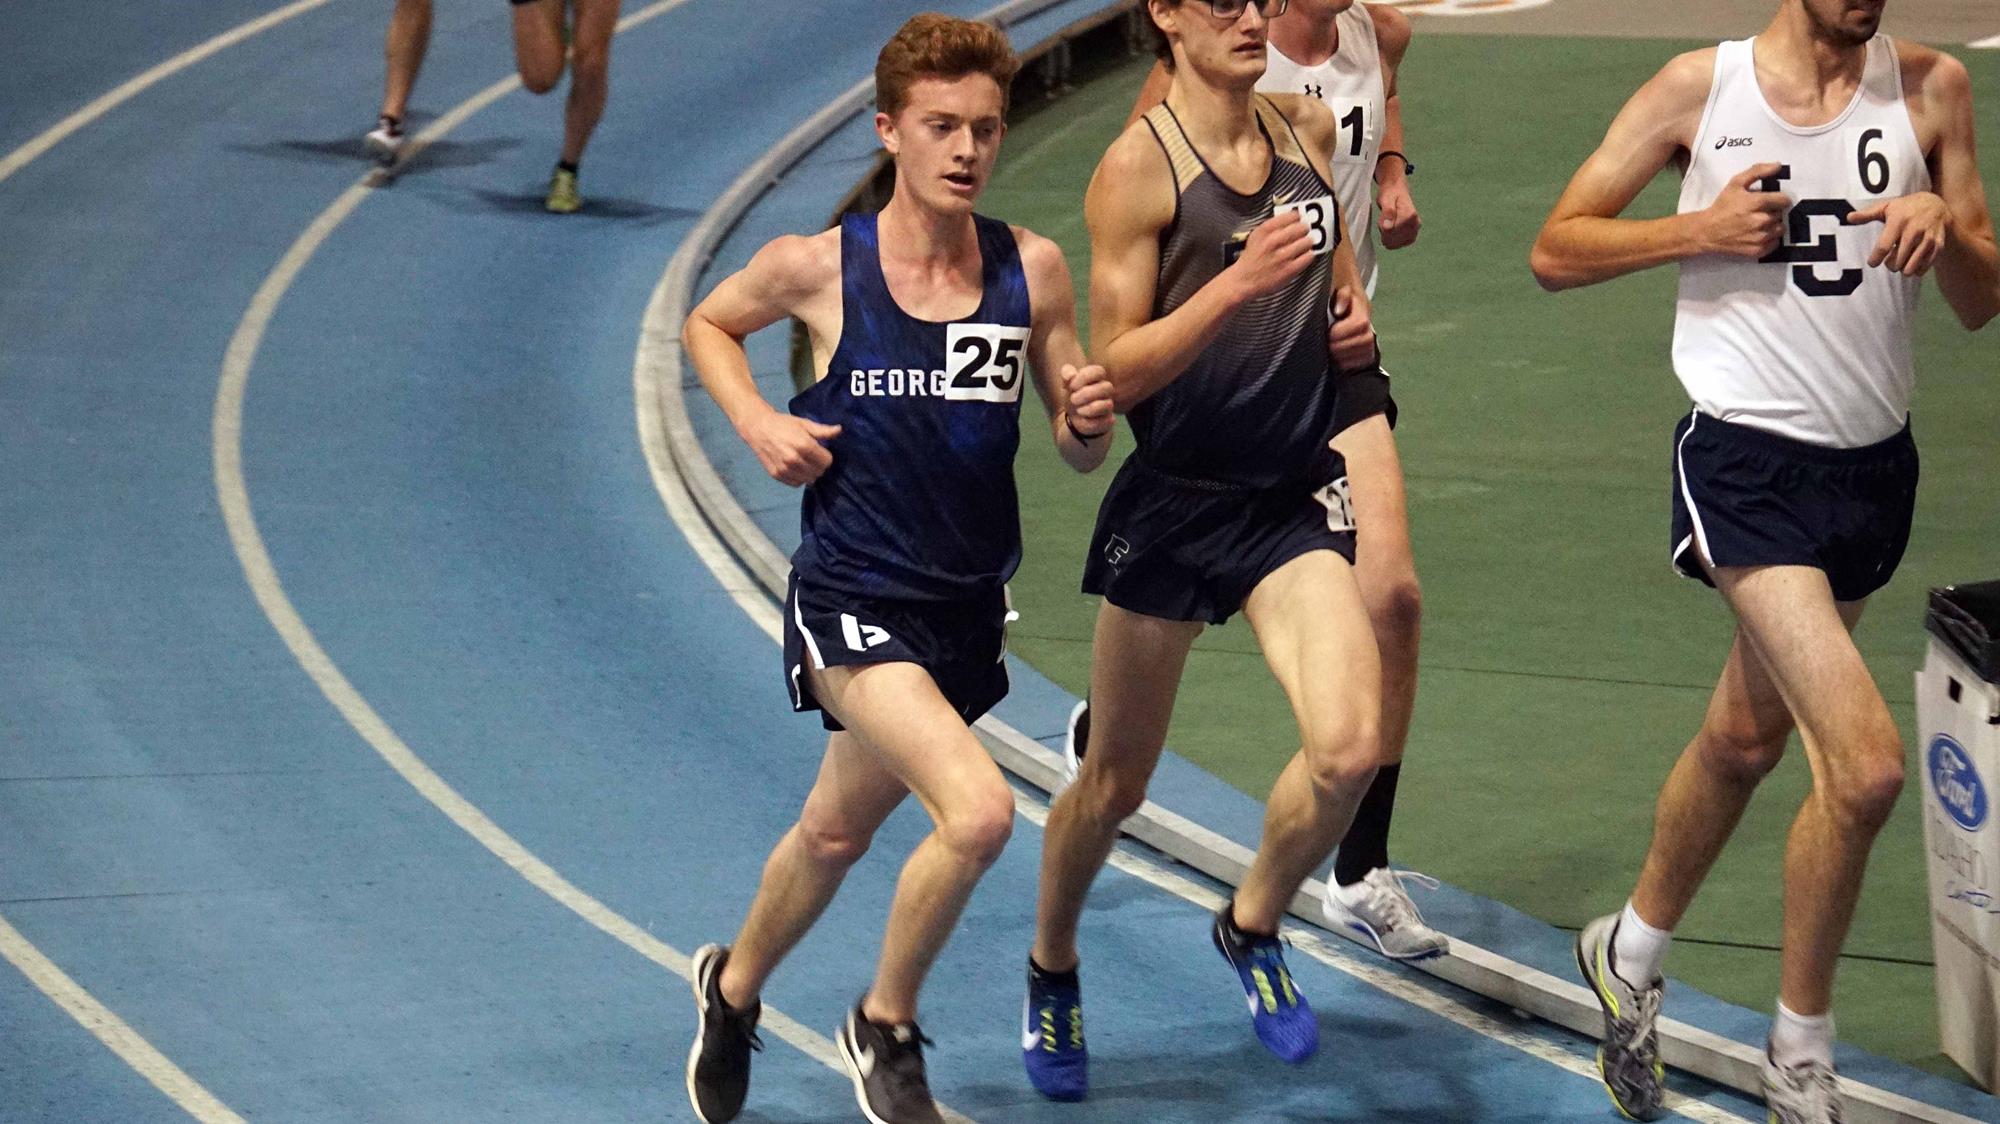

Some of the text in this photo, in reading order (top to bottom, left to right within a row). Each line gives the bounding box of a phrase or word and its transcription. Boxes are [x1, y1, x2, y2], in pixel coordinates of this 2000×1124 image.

[1340, 106, 1364, 156] 1
[1727, 136, 1753, 147] asics
[1857, 128, 1890, 194] 6
[1291, 202, 1327, 251] 3
[850, 368, 946, 397] GEORG
[951, 336, 1023, 391] 25
[1935, 745, 1977, 820] Ford
